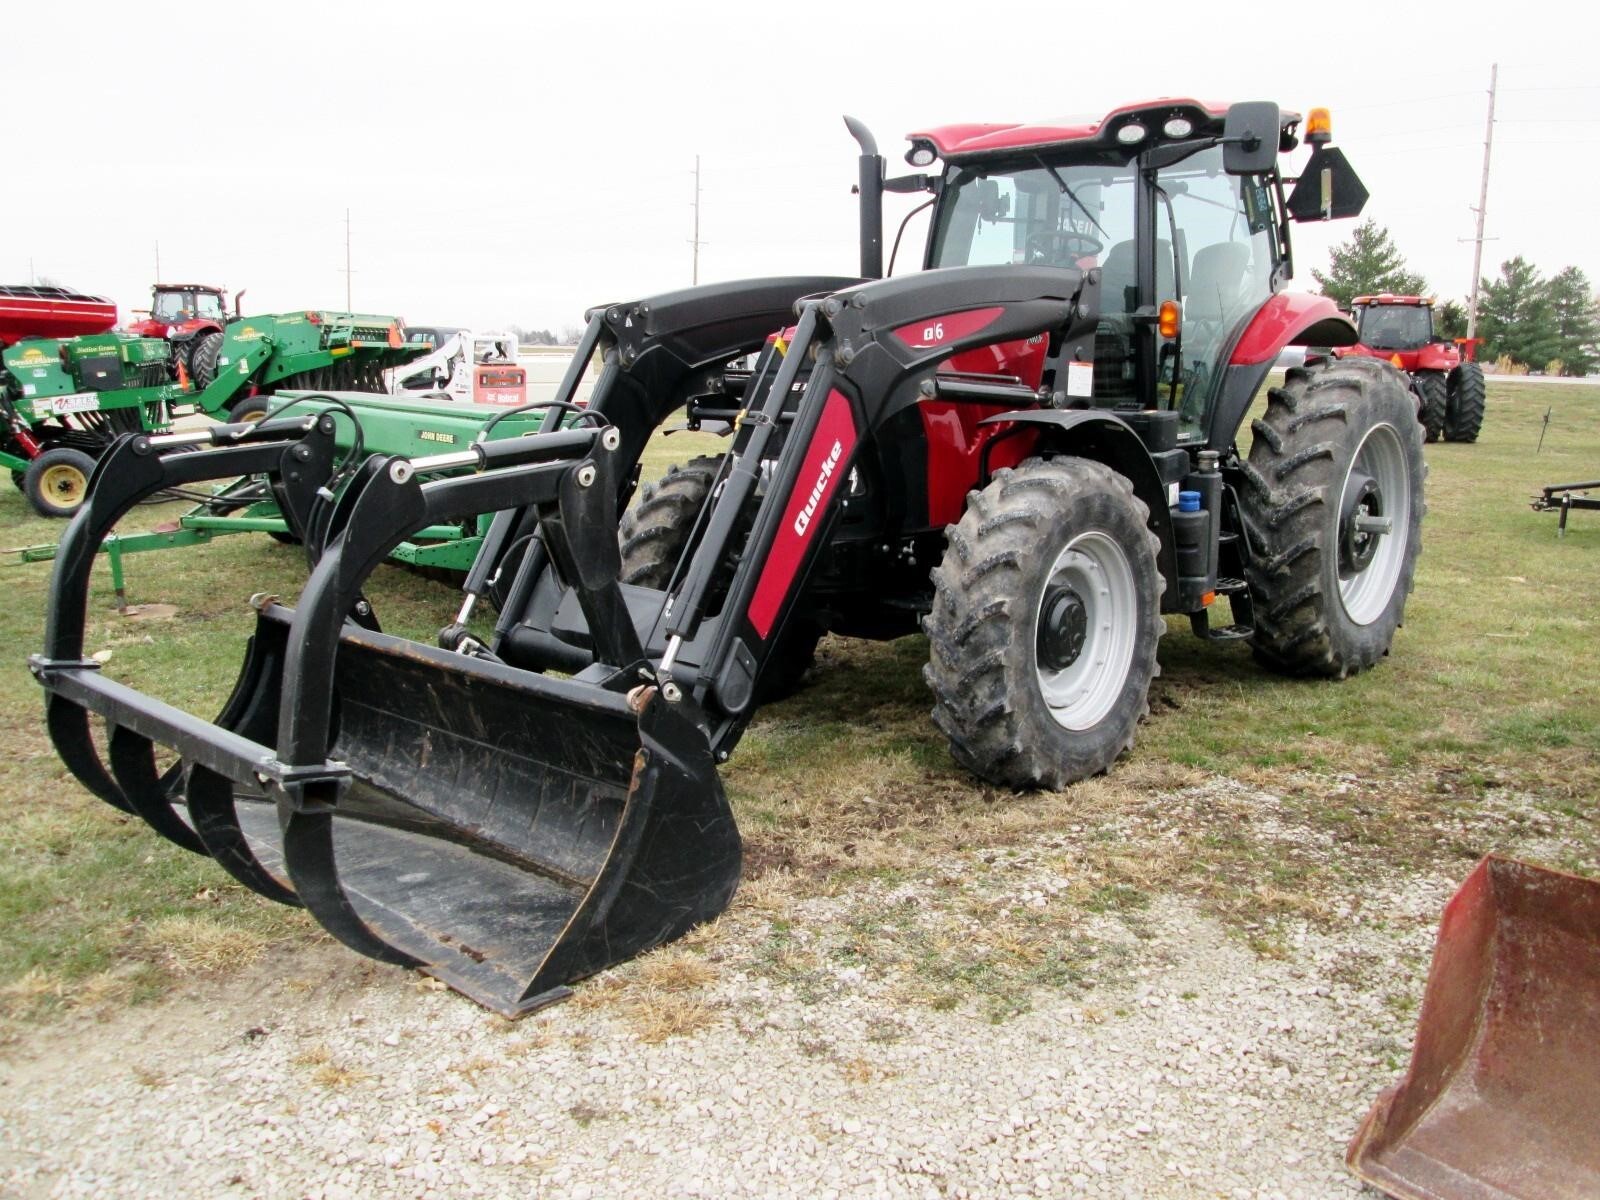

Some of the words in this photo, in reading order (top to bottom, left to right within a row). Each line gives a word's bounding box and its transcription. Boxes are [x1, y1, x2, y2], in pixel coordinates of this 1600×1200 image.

[421, 431, 435, 441] JOHN
[435, 433, 454, 444] DEERE
[794, 439, 842, 536] Quicke
